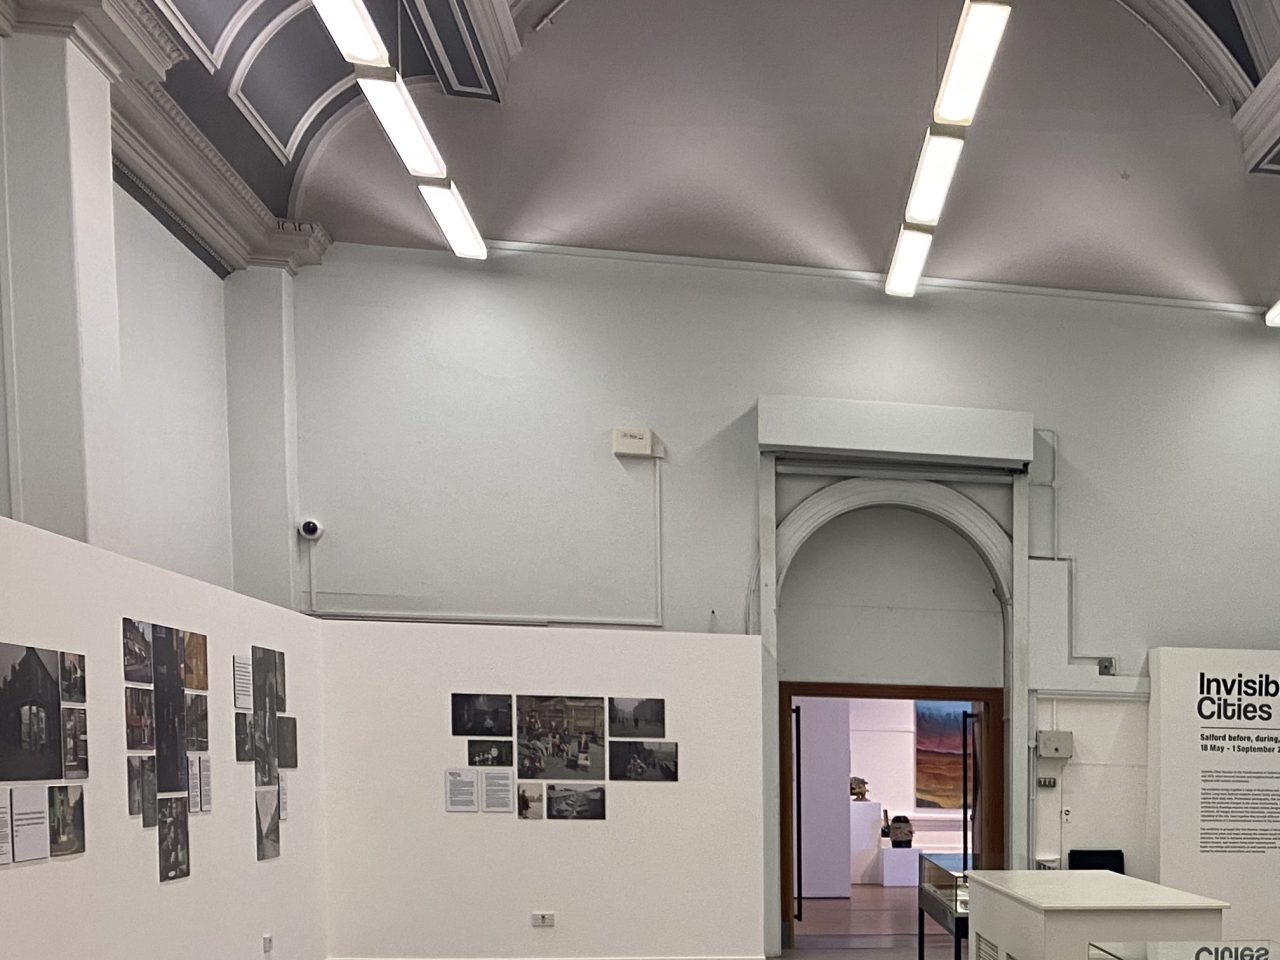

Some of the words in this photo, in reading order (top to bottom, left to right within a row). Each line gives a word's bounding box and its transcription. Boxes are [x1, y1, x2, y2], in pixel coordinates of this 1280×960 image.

[1197, 696, 1272, 721] Cities
[1200, 733, 1226, 742] Salford
[1228, 734, 1253, 743] before,
[1255, 735, 1280, 744] during,
[1200, 744, 1208, 752] 18
[1209, 744, 1224, 753] May
[1237, 744, 1275, 754] September
